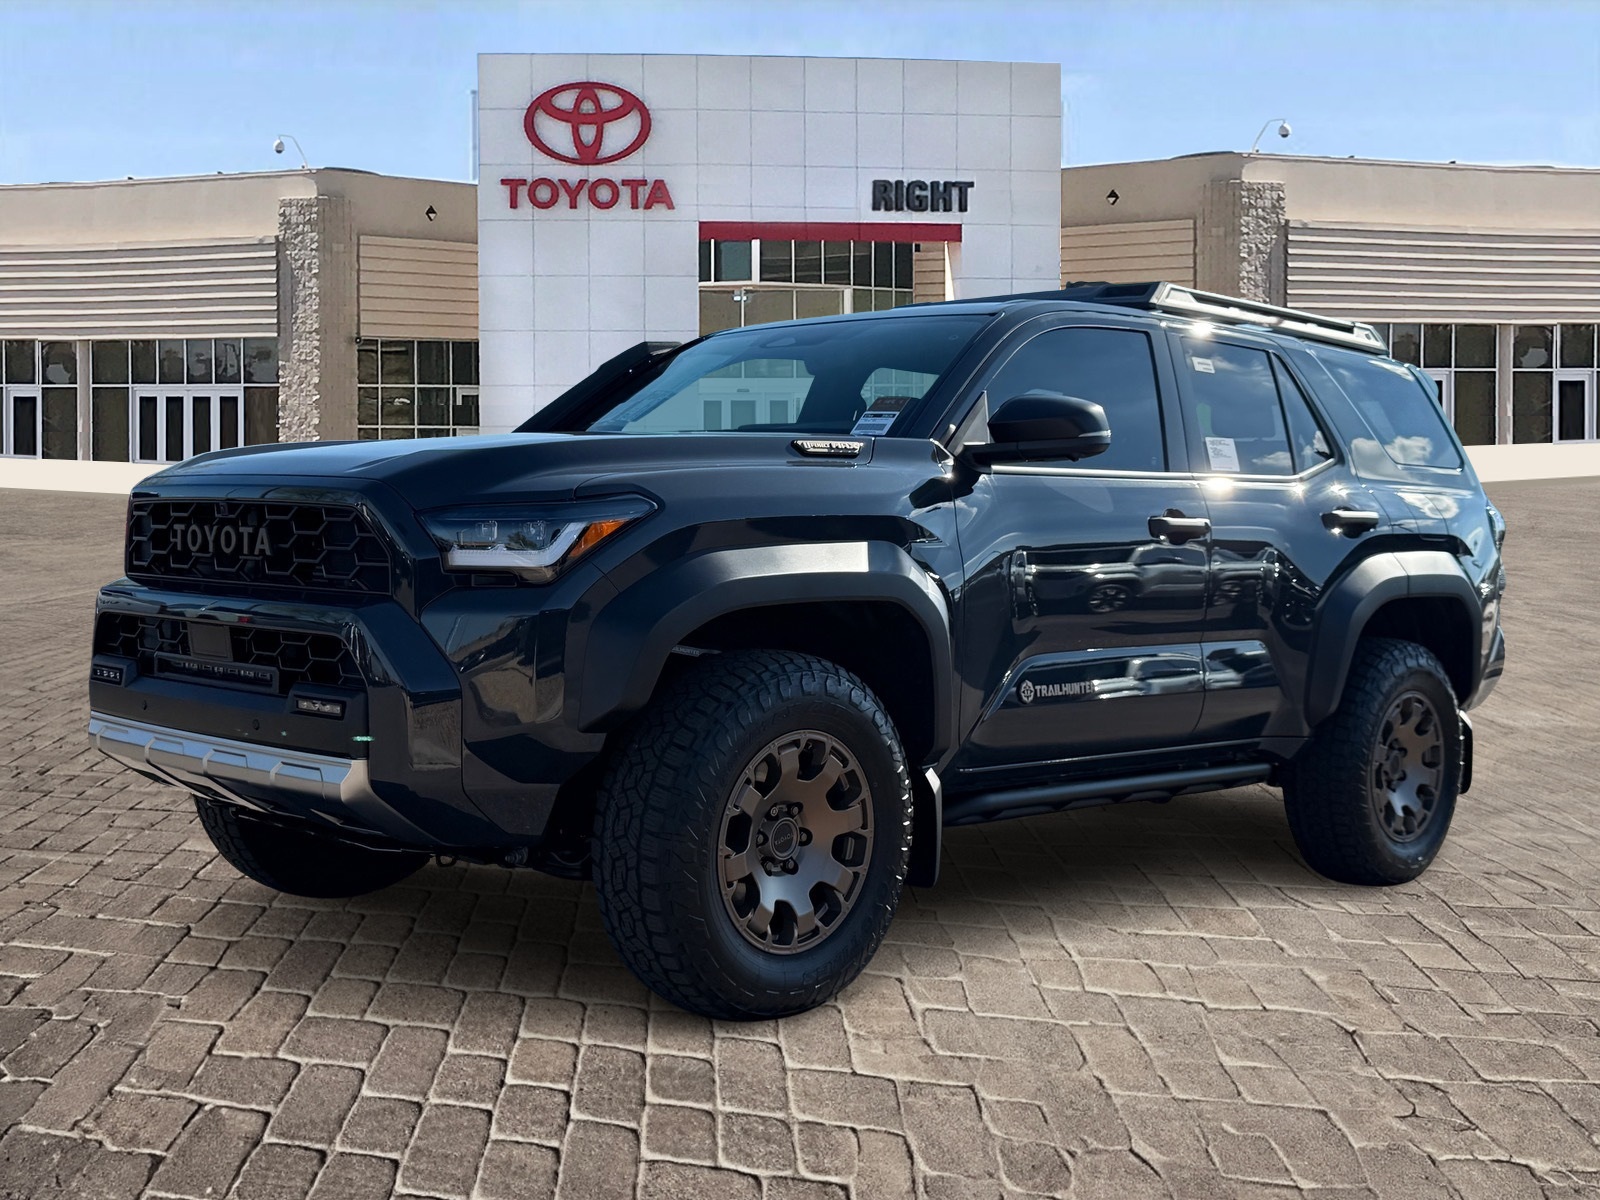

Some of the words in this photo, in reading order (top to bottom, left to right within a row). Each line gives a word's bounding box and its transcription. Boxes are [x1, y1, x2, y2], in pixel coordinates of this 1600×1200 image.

[500, 177, 675, 210] TOYOTA
[872, 179, 974, 212] RIGHT
[173, 523, 272, 556] TOYOTA
